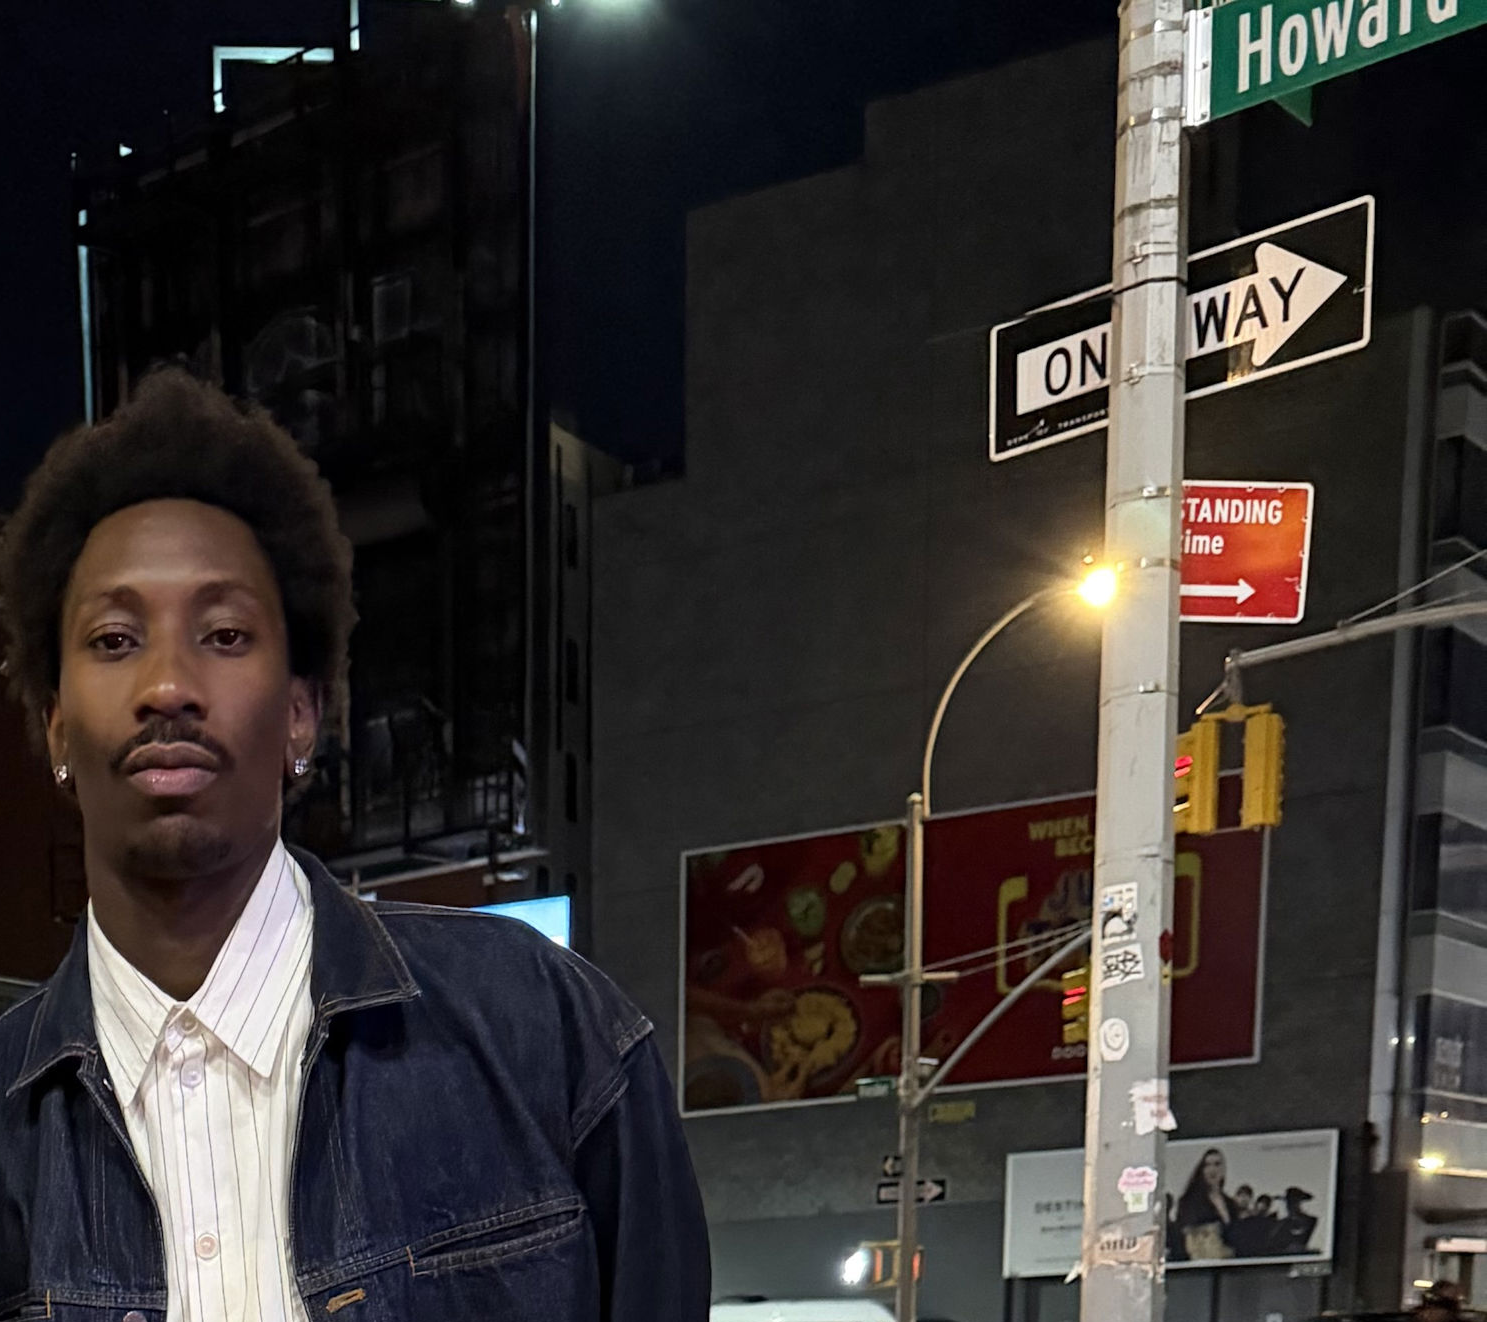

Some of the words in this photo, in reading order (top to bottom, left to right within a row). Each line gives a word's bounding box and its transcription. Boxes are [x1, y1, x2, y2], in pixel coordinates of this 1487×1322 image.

[1237, 0, 1458, 94] Howar
[1044, 332, 1108, 396] ON
[1193, 266, 1306, 349] WAY
